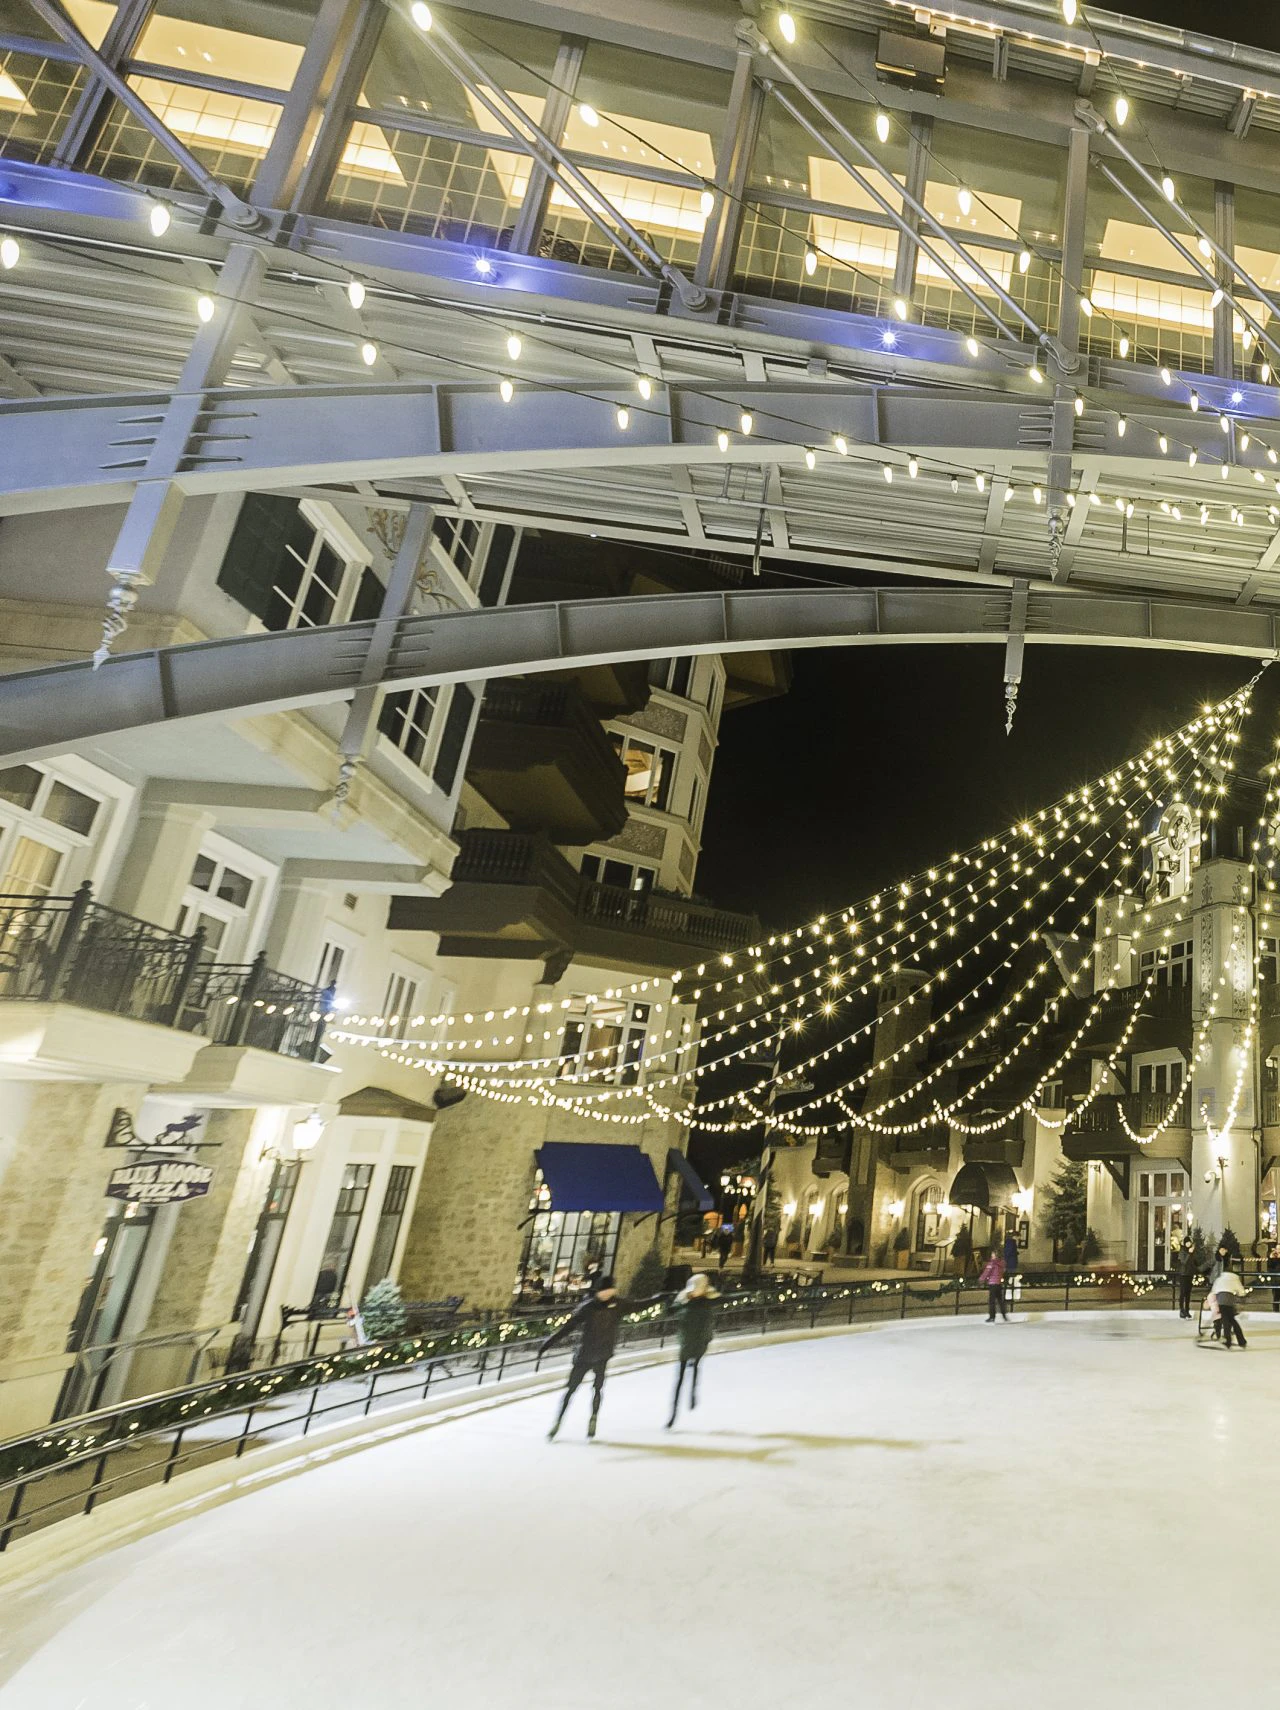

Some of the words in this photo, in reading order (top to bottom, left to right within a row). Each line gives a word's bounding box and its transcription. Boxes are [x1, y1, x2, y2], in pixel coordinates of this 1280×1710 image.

[110, 1165, 160, 1185] BLUE
[156, 1163, 213, 1184] MOOSE
[126, 1183, 191, 1198] PIZZA
